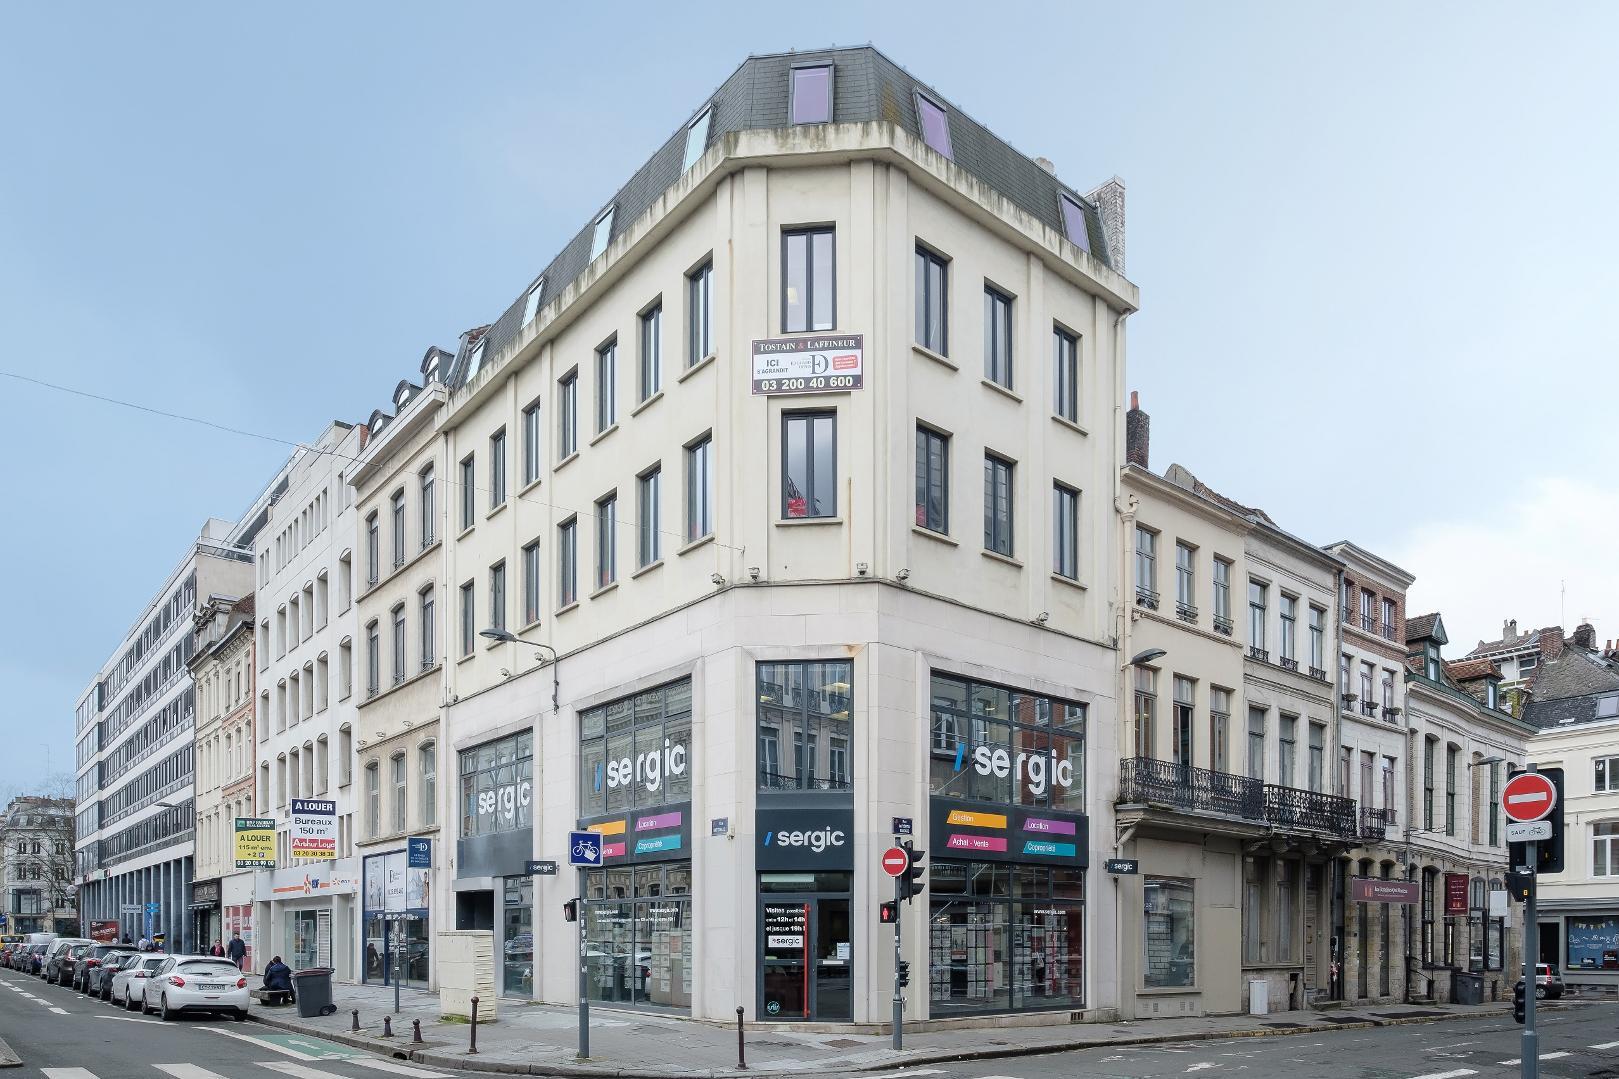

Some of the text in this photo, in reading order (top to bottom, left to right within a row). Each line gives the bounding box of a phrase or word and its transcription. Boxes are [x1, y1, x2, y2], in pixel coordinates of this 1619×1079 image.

[760, 342, 795, 351] TOSTAIN
[808, 340, 855, 349] LAFFINEUR
[762, 376, 853, 390] 03 200 40 600
[607, 738, 685, 791] sergic
[975, 746, 1073, 794] sergic
[479, 776, 530, 819] sergic
[304, 803, 333, 811] LOUER
[1028, 820, 1048, 830] Location
[293, 838, 335, 848] Arthur Loyd
[777, 825, 845, 852] sergic
[533, 864, 553, 872] sergic
[1114, 863, 1132, 871] sergic
[776, 937, 800, 946] sergic
